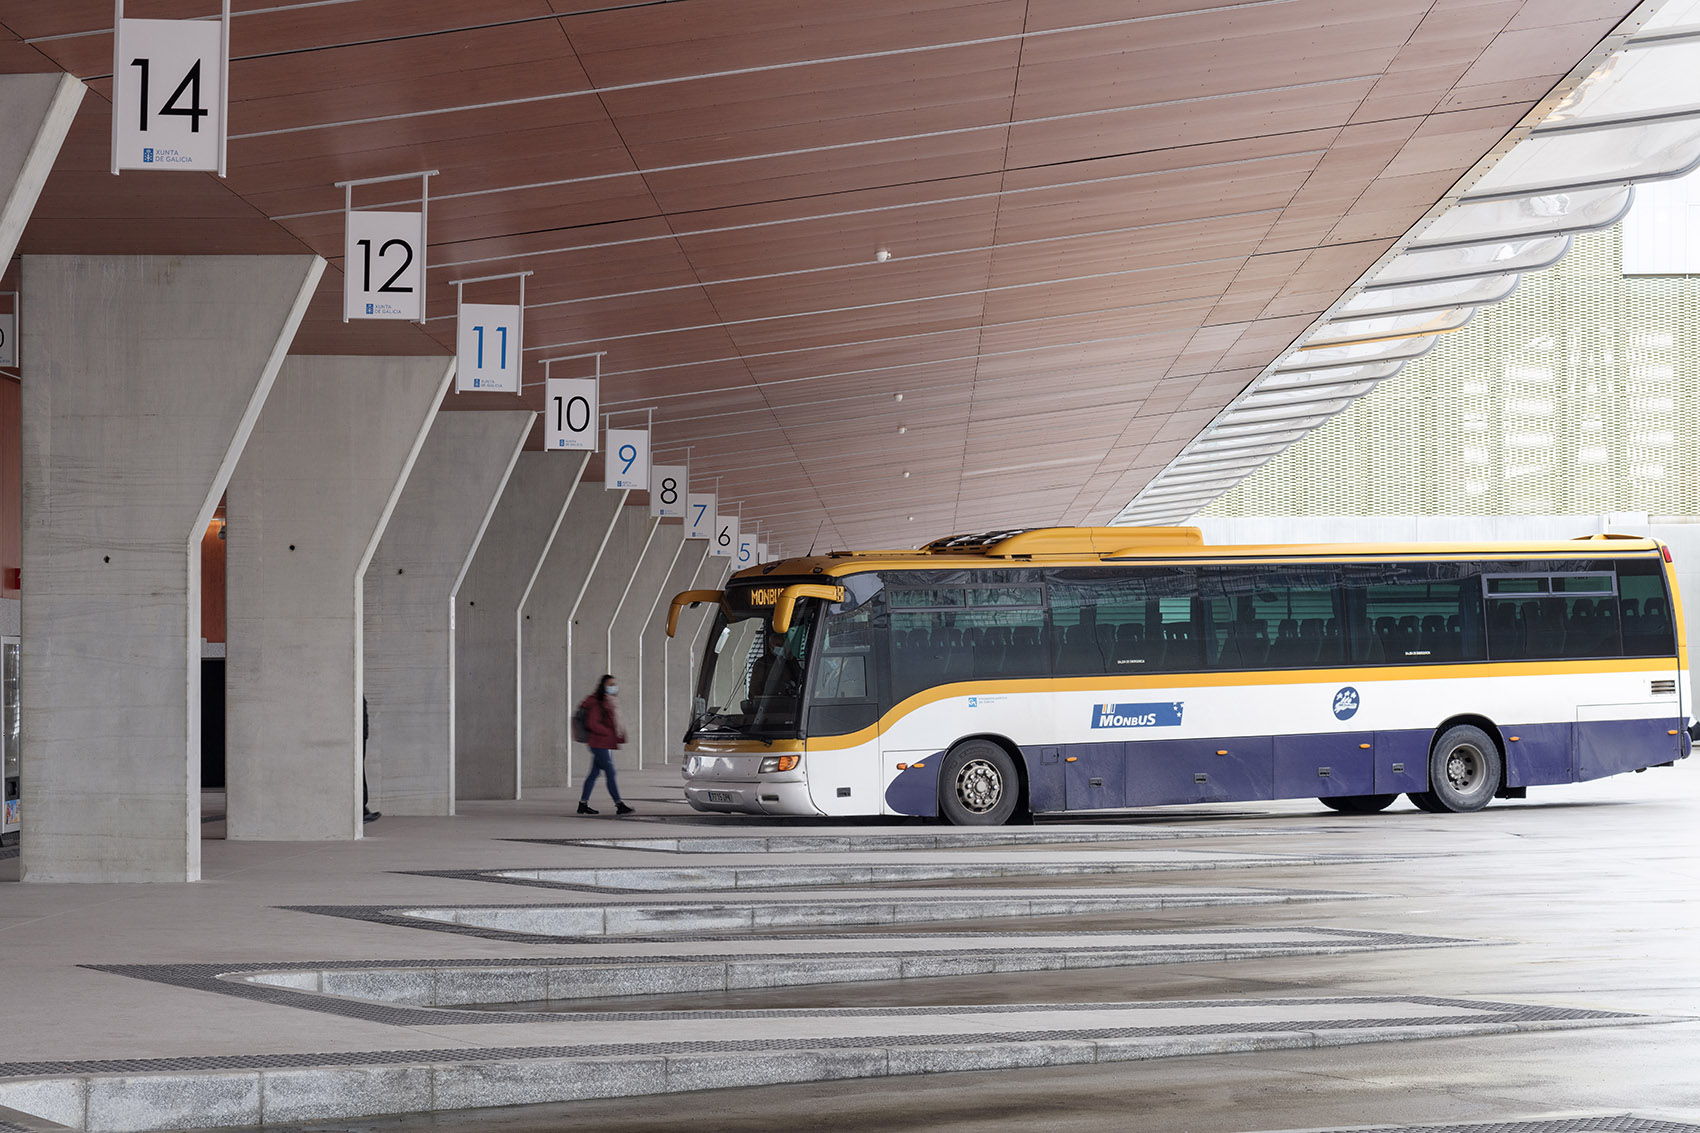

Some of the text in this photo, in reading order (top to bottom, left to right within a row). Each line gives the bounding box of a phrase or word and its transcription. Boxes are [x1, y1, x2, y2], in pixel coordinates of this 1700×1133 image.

[131, 59, 208, 132] 14
[357, 239, 413, 292] 12
[473, 327, 506, 369] 11
[554, 396, 589, 432] 10
[619, 445, 636, 474] 9
[661, 478, 677, 504] 8
[693, 505, 707, 527] 7
[718, 526, 730, 546] 6
[739, 544, 750, 561] 5
